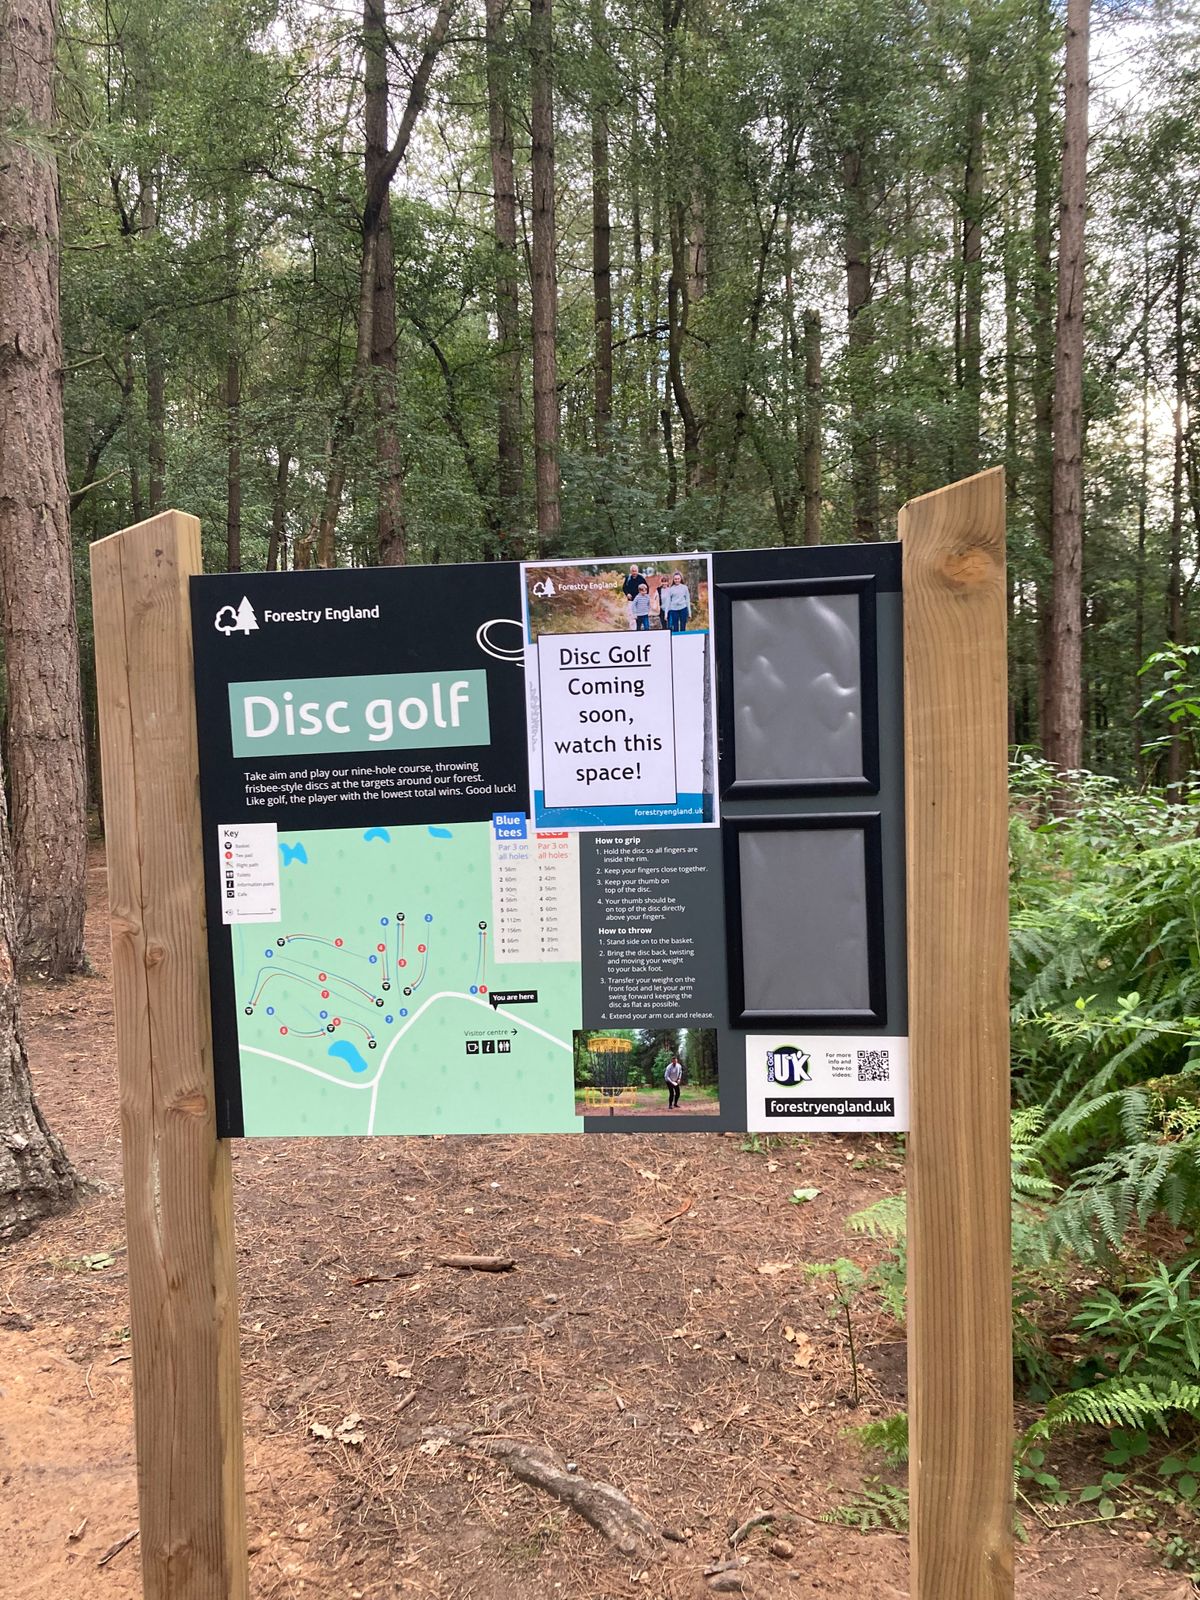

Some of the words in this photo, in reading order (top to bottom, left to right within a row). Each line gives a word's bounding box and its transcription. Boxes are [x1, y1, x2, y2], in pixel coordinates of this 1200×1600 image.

[265, 611, 321, 621] Forestry
[325, 606, 379, 620] England
[560, 649, 600, 664] Disc
[609, 645, 651, 662] Golf
[568, 677, 644, 696] Coming
[244, 692, 350, 738] Disc
[365, 680, 470, 742] golf
[580, 710, 633, 725] soon,
[555, 737, 616, 753] watch
[624, 735, 662, 751] this
[244, 772, 267, 780] Take
[289, 770, 307, 778] and
[310, 769, 330, 779] play
[351, 766, 396, 775] nine-hole
[435, 763, 479, 771] throwing
[576, 764, 640, 784] space!
[245, 784, 303, 792] frisbee-style
[305, 782, 329, 790] discs
[343, 780, 359, 788] the
[361, 780, 394, 789] targets
[397, 776, 431, 785] around
[246, 797, 265, 805] Like
[267, 795, 287, 806] golf,
[290, 795, 306, 803] the
[308, 794, 338, 804] player
[340, 792, 360, 800] with
[363, 791, 379, 799] the
[415, 788, 436, 797] total
[466, 786, 492, 794] Good
[494, 784, 516, 792] luck!
[635, 808, 704, 816] forestryengland.uk
[496, 816, 520, 825] Blue
[224, 830, 239, 838] Key
[499, 829, 522, 837] tees
[625, 837, 640, 845] grip
[662, 957, 683, 965] weight
[771, 1101, 891, 1114] forestryengland.uk
